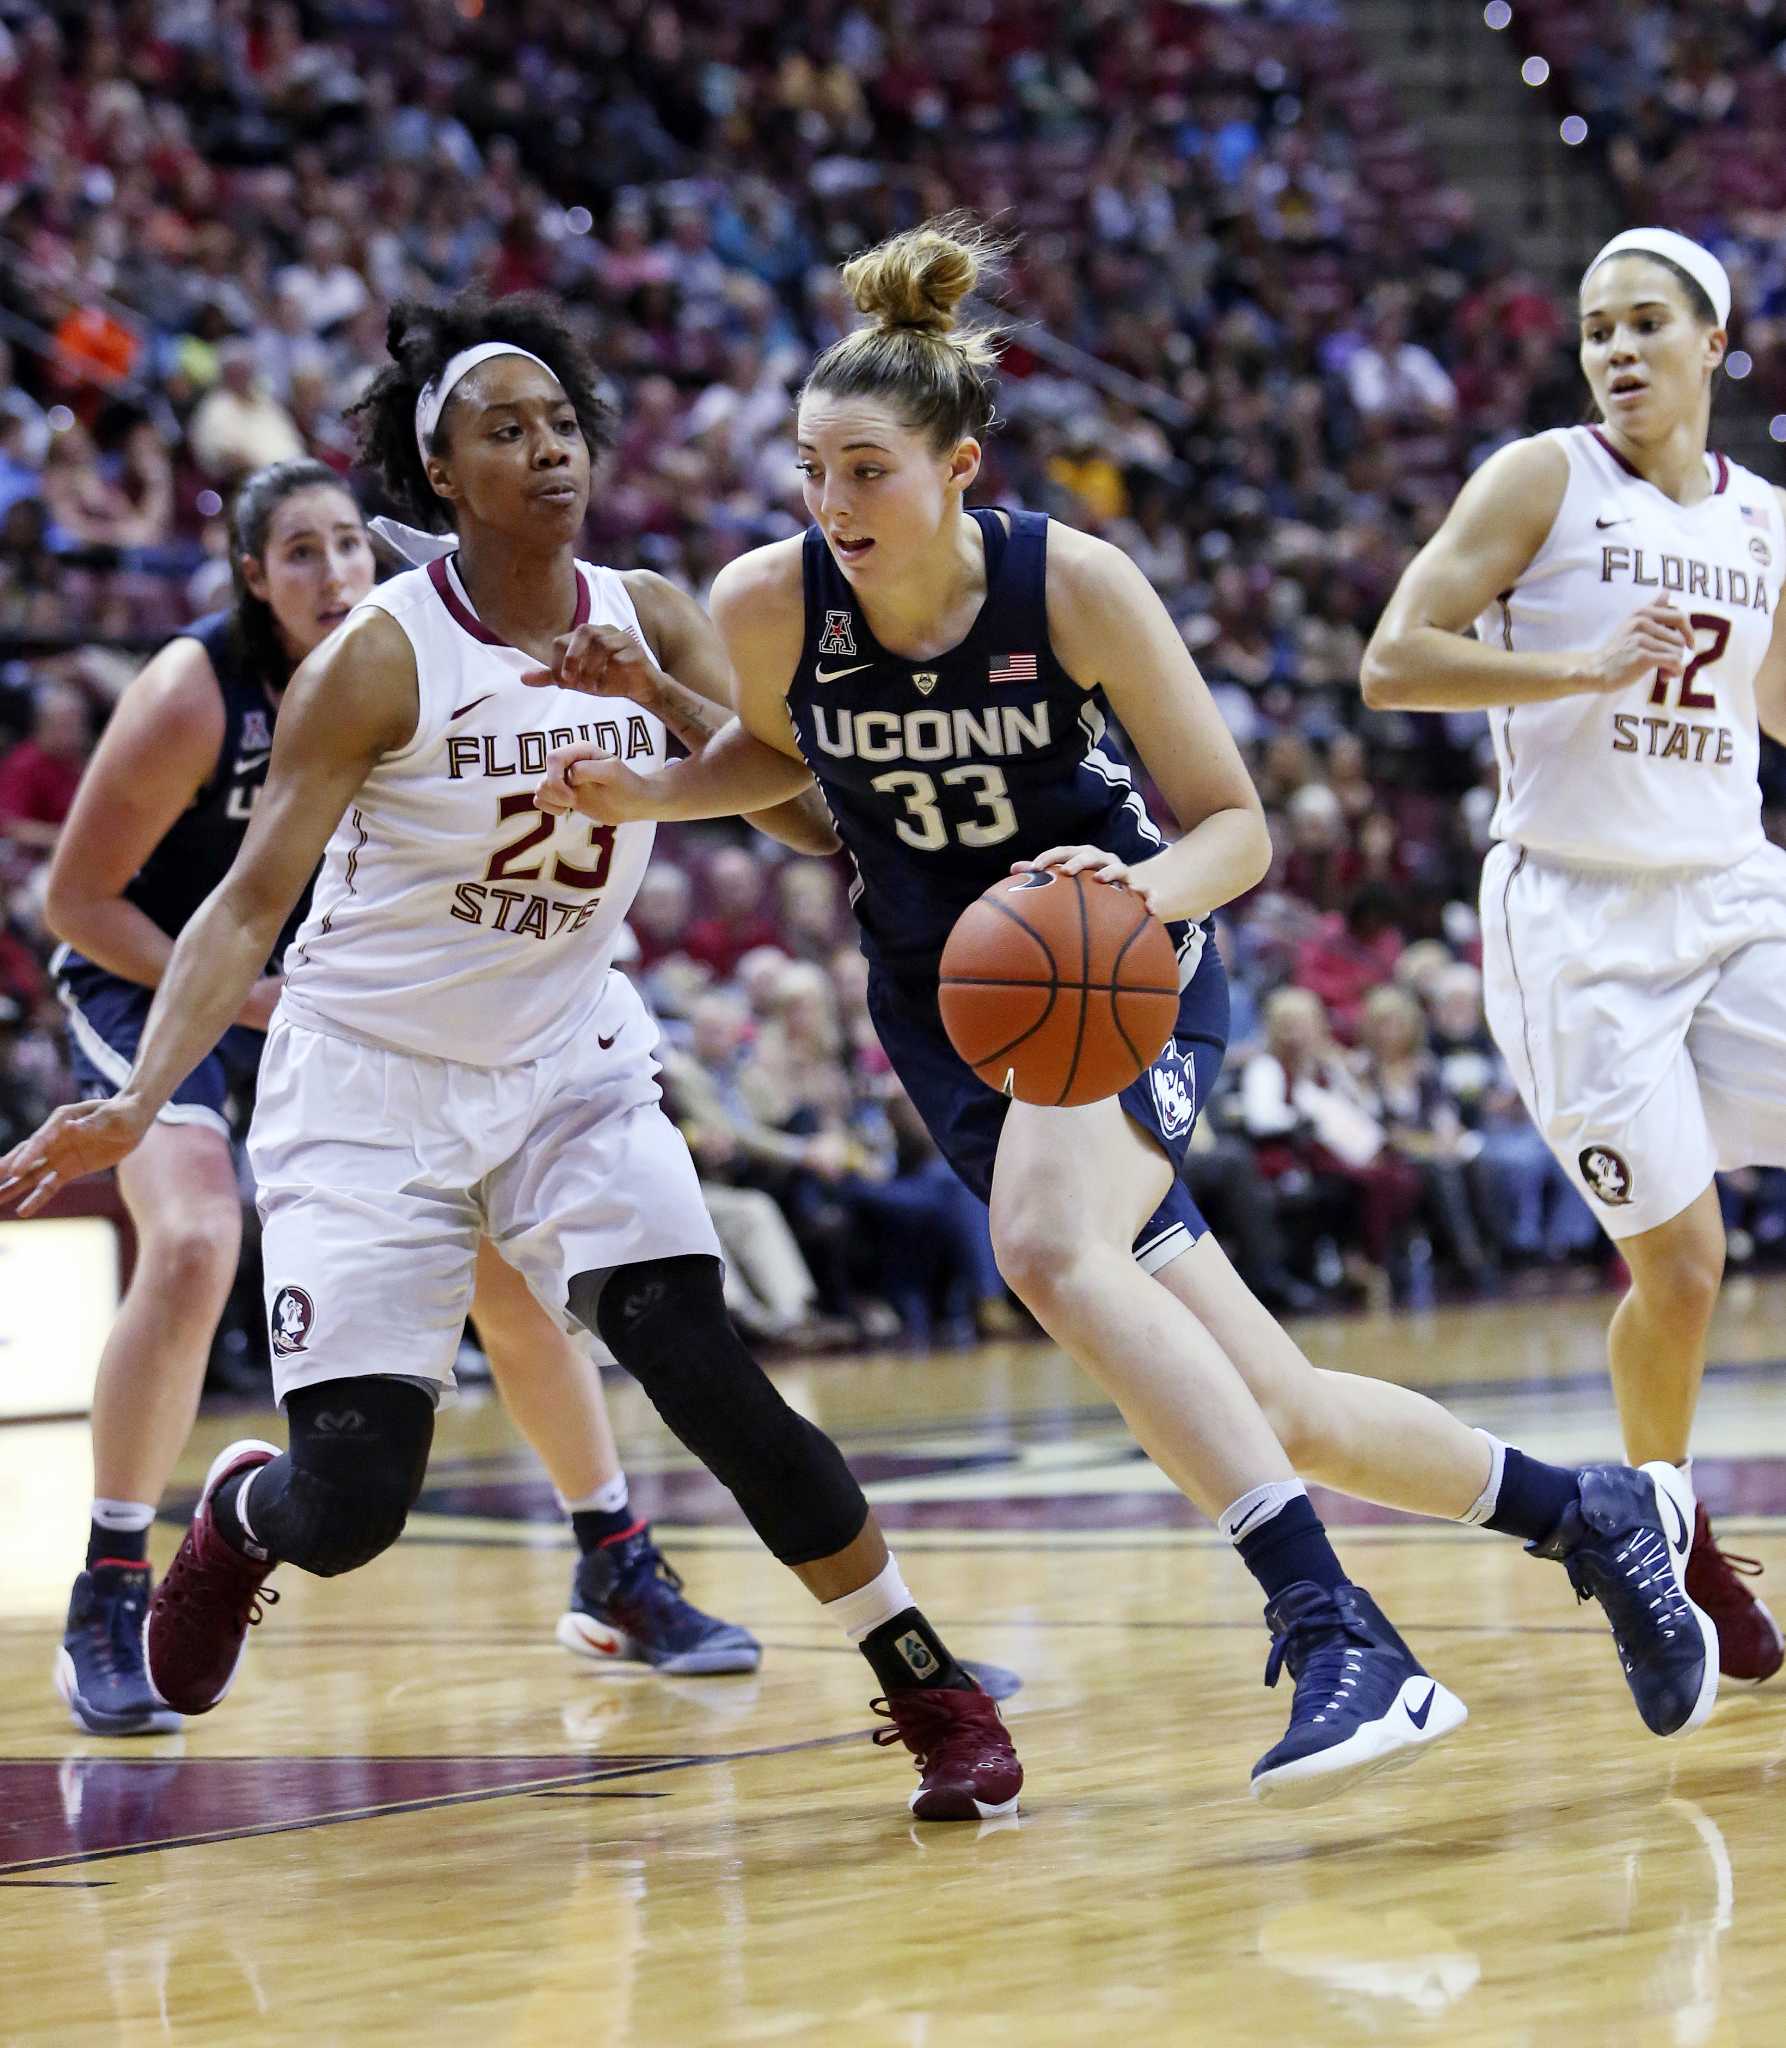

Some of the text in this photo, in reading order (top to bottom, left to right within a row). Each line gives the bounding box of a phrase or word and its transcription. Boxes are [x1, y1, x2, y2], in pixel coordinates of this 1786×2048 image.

[1601, 546, 1768, 615] FLORIDA
[811, 701, 1051, 762] UCONN
[1613, 713, 1733, 764] STATE
[870, 764, 1019, 851] 33
[450, 882, 601, 940] STATE
